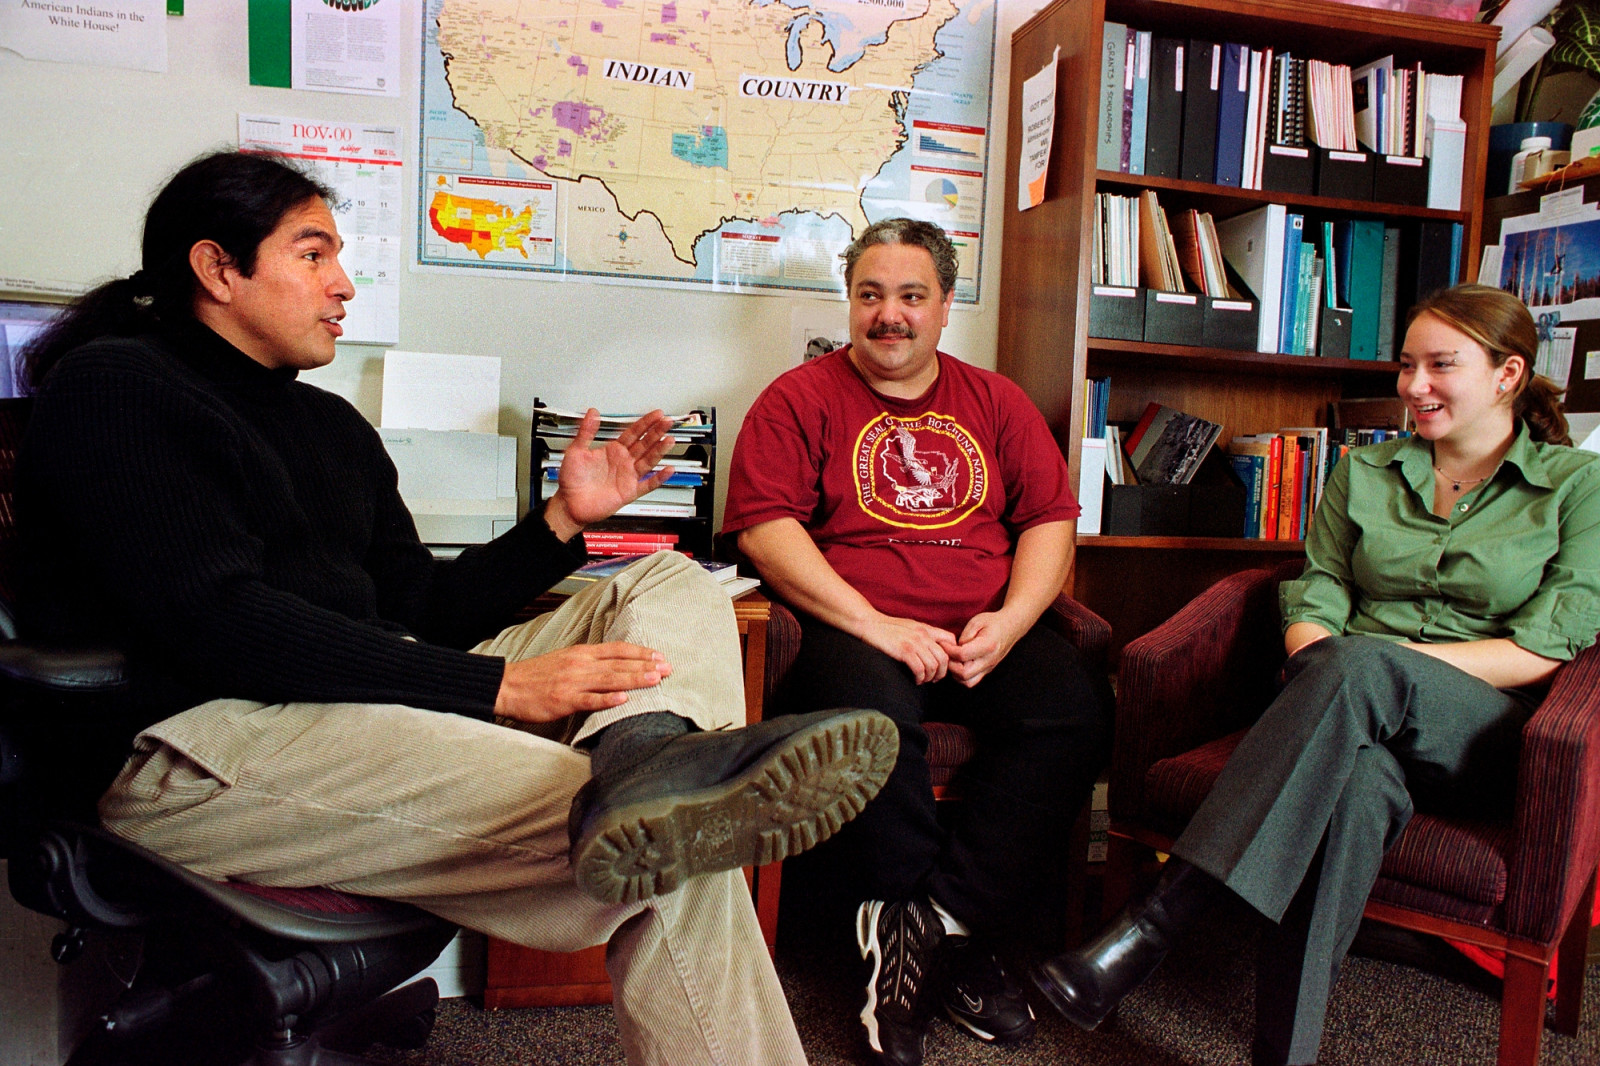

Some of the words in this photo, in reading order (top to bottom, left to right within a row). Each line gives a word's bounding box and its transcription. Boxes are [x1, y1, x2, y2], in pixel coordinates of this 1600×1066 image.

[21, 0, 73, 13] American
[76, 5, 114, 18] Indians
[117, 10, 126, 19] in
[129, 11, 145, 22] the
[48, 15, 80, 29] White
[83, 19, 120, 33] House!
[1106, 41, 1116, 79] GRANTS
[605, 61, 692, 89] INDIAN
[742, 78, 848, 102] COUNTRY
[1105, 90, 1114, 144] SCHOLARSHIPS
[577, 205, 606, 213] MEXICO
[865, 423, 886, 443] SEAL
[859, 442, 872, 479] GREAT
[862, 482, 874, 506] THE
[972, 458, 984, 501] NATION
